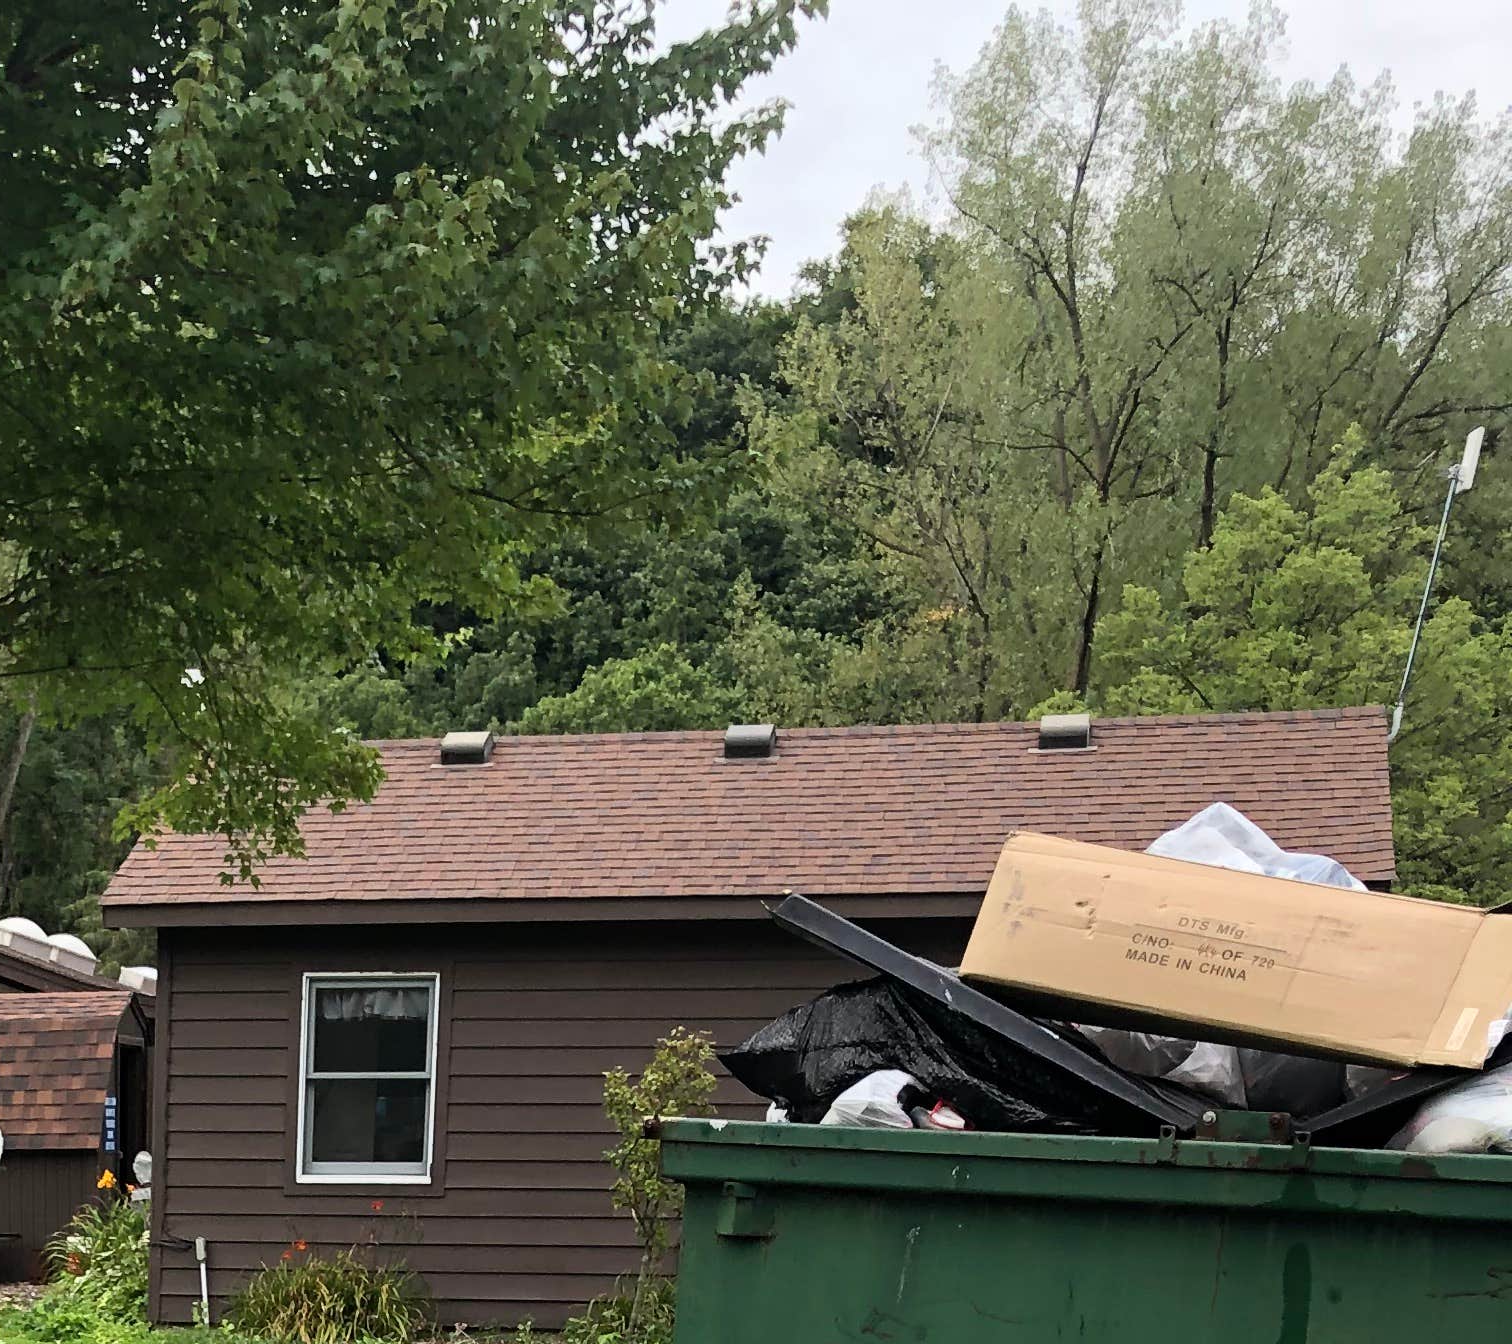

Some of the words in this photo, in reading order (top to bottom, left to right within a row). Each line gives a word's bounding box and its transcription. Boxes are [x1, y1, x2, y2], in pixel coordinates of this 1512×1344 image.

[1177, 916, 1210, 932] DTS
[1124, 948, 1170, 967] MADE
[1175, 957, 1193, 971] IN
[1198, 962, 1248, 982] CHINA
[1221, 949, 1244, 962] OF
[1251, 955, 1276, 970] 720
